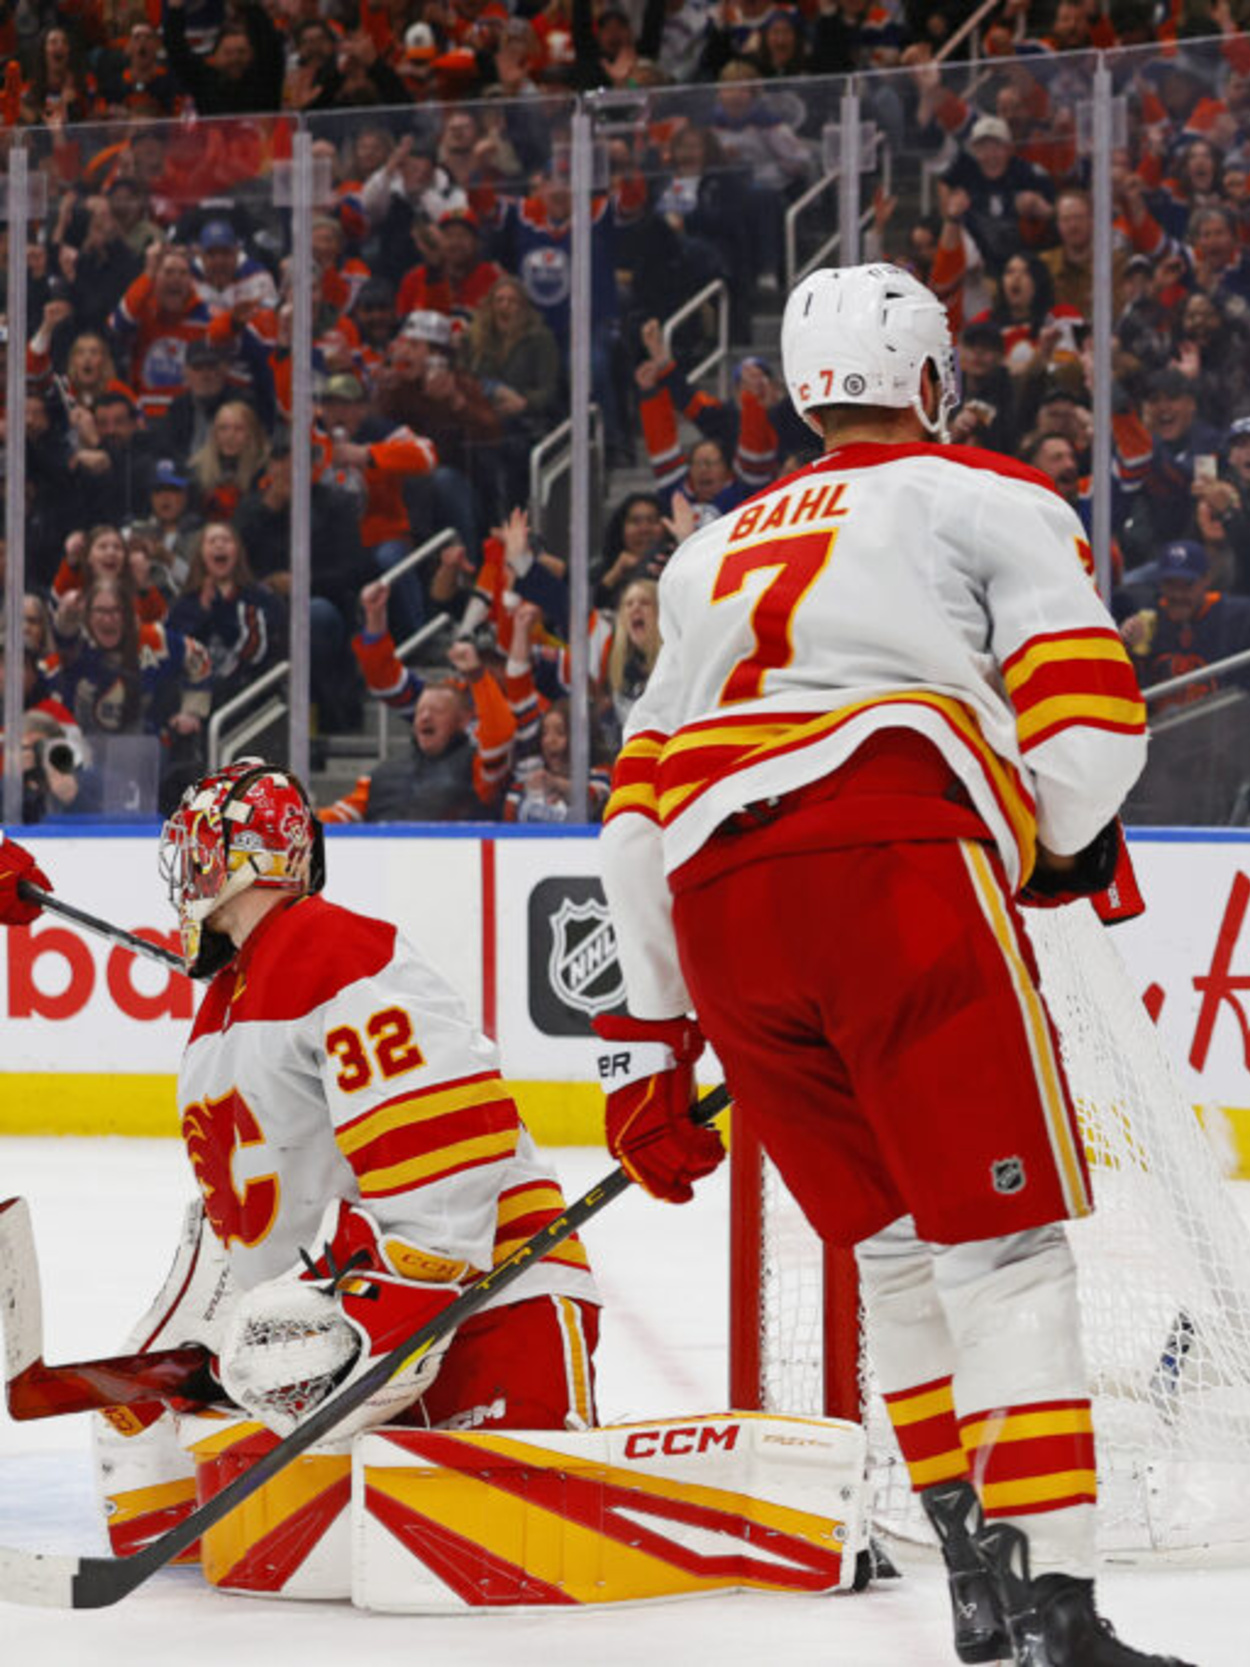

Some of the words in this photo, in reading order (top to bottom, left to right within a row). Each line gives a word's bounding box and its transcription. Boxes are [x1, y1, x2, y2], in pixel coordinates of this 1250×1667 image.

[819, 369, 835, 397] 7
[728, 483, 849, 542] BAHL
[711, 526, 840, 707] 7
[568, 925, 618, 988] NHL
[325, 1005, 428, 1094] 32
[624, 1424, 741, 1460] CCM
